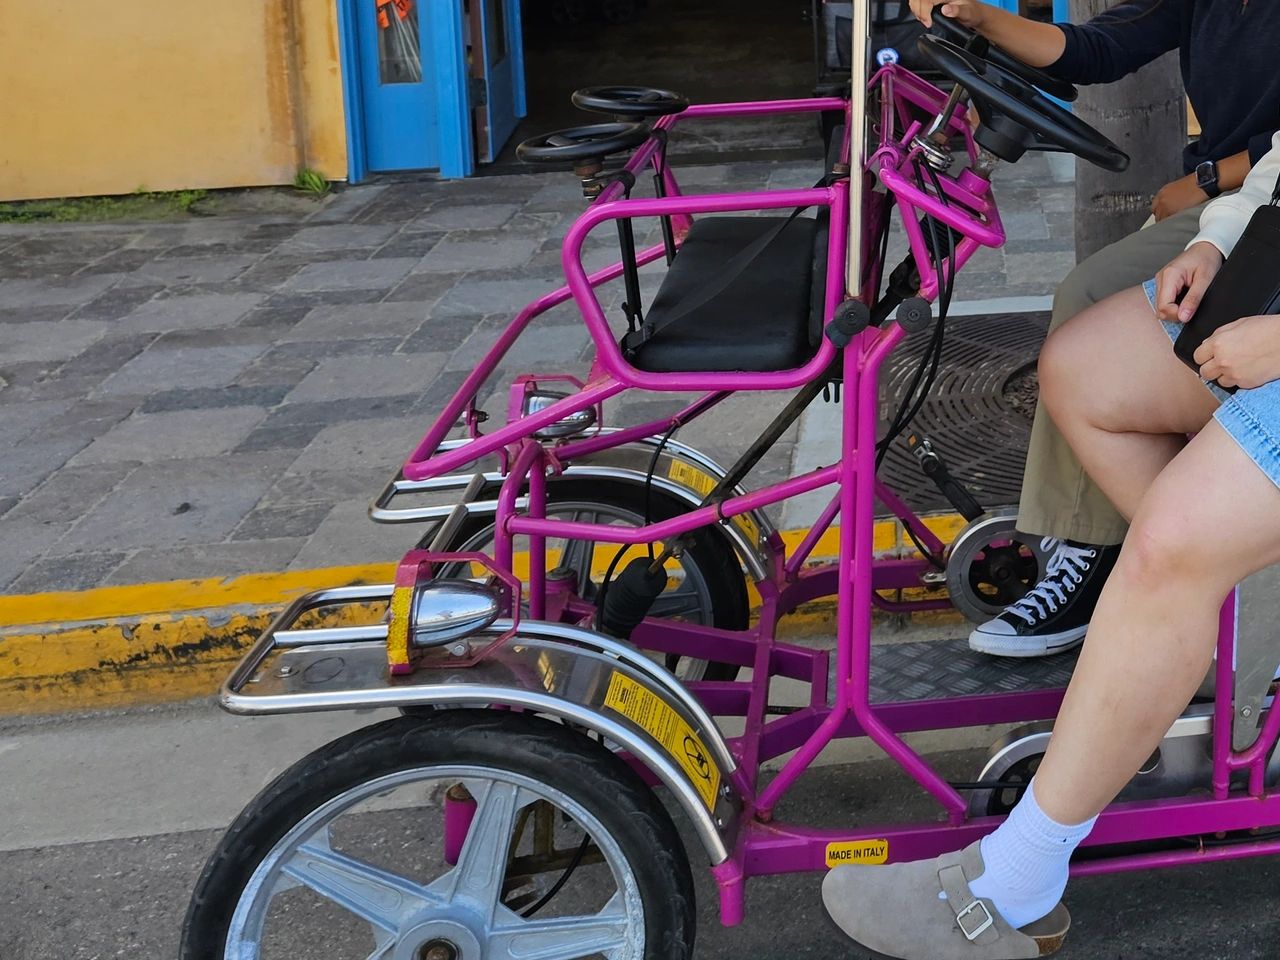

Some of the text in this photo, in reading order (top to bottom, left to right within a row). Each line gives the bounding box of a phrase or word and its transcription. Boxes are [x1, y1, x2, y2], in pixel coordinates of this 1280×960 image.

[828, 846, 886, 860] MADE IN ITALY
